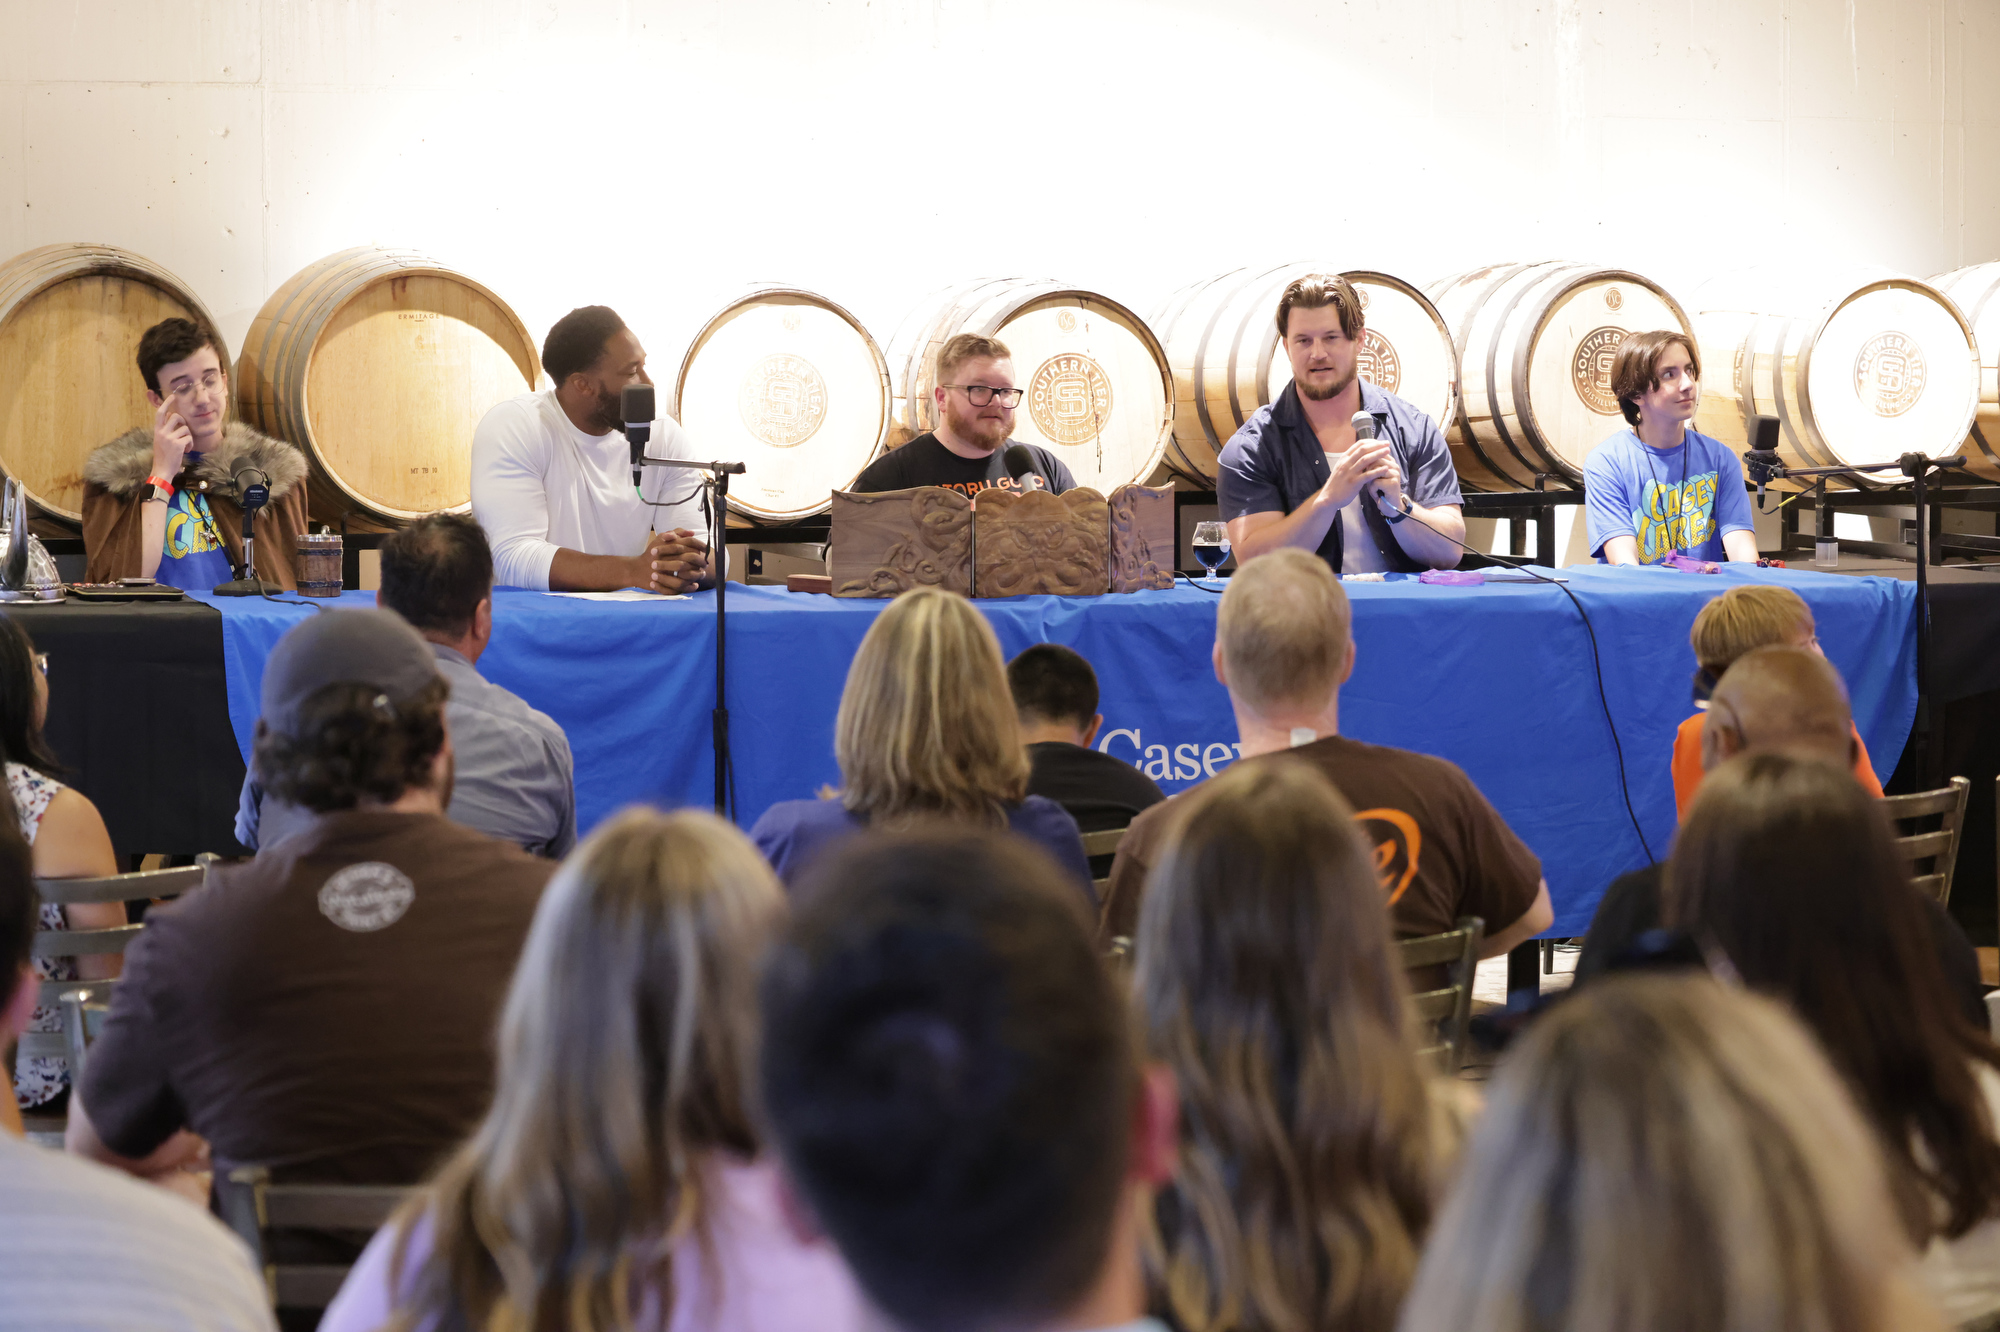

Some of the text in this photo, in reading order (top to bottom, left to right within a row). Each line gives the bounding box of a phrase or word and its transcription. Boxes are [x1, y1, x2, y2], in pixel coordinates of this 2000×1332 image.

[1380, 349, 1395, 385] TIER
[1577, 332, 1621, 379] SOUTHER
[1858, 336, 1923, 388] SOUTHERN TIER
[745, 359, 822, 416] SOUTHERN TIER
[1034, 359, 1107, 412] SOUTHERN TIER
[1583, 386, 1618, 407] DISTILLIN
[1044, 418, 1089, 437] DISTILLING
[935, 475, 1045, 496] TORU GOO
[1650, 473, 1719, 522] CASEY
